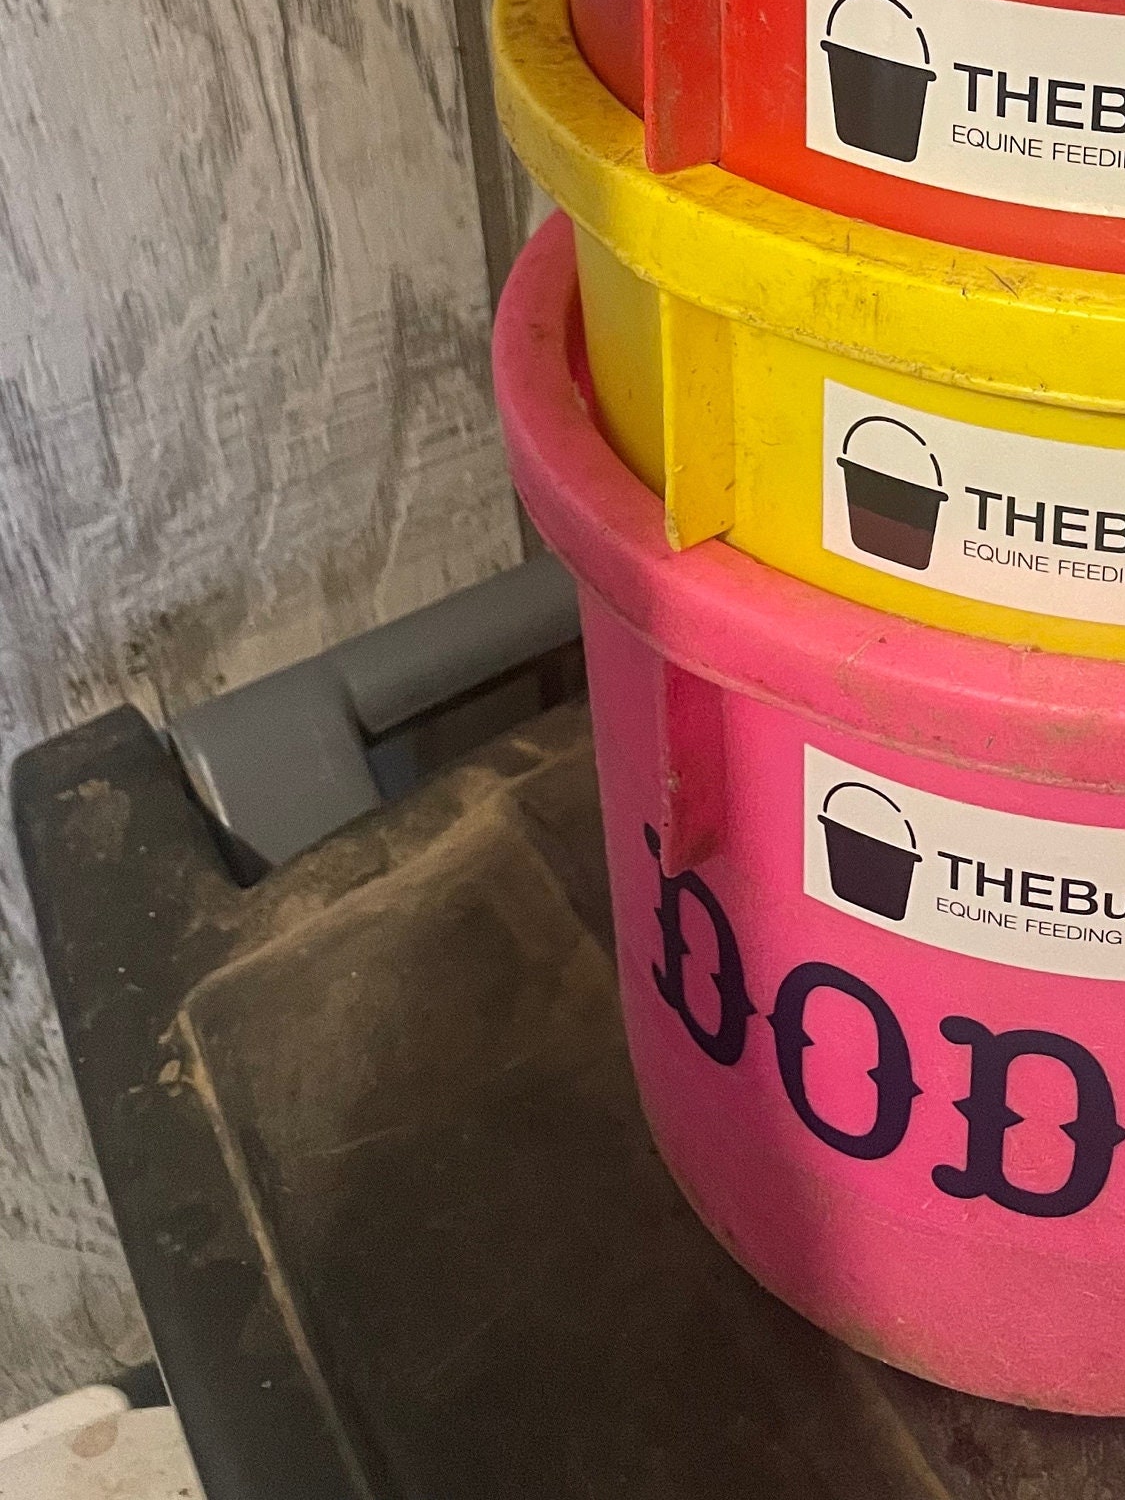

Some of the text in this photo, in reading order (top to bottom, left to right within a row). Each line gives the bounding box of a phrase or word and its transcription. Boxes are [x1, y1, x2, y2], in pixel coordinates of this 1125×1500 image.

[952, 124, 1043, 159] EQUINE
[963, 539, 1049, 574] EQUINE
[936, 897, 1018, 931] EQUINE
[1026, 917, 1123, 946] FEEDING
